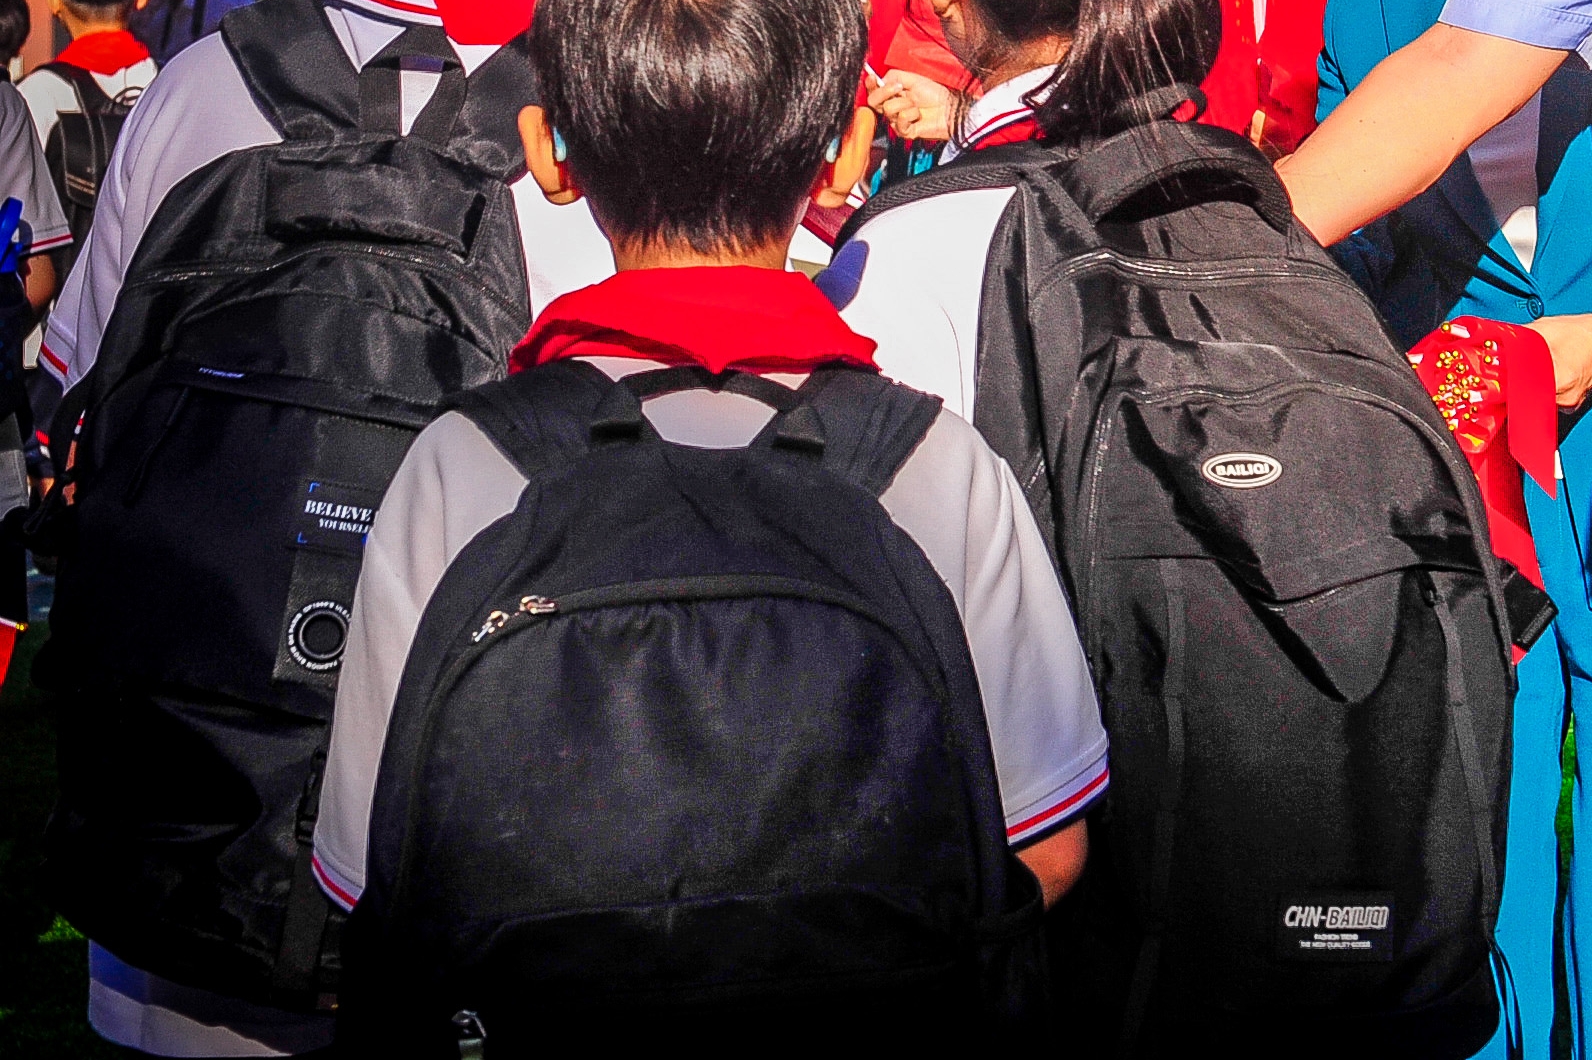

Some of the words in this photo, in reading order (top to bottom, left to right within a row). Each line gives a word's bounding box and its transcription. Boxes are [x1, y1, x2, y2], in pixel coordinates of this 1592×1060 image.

[1214, 462, 1270, 477] BAILIQI
[304, 499, 373, 523] BELIEVE
[1284, 905, 1390, 930] CHN-BAILIQI
